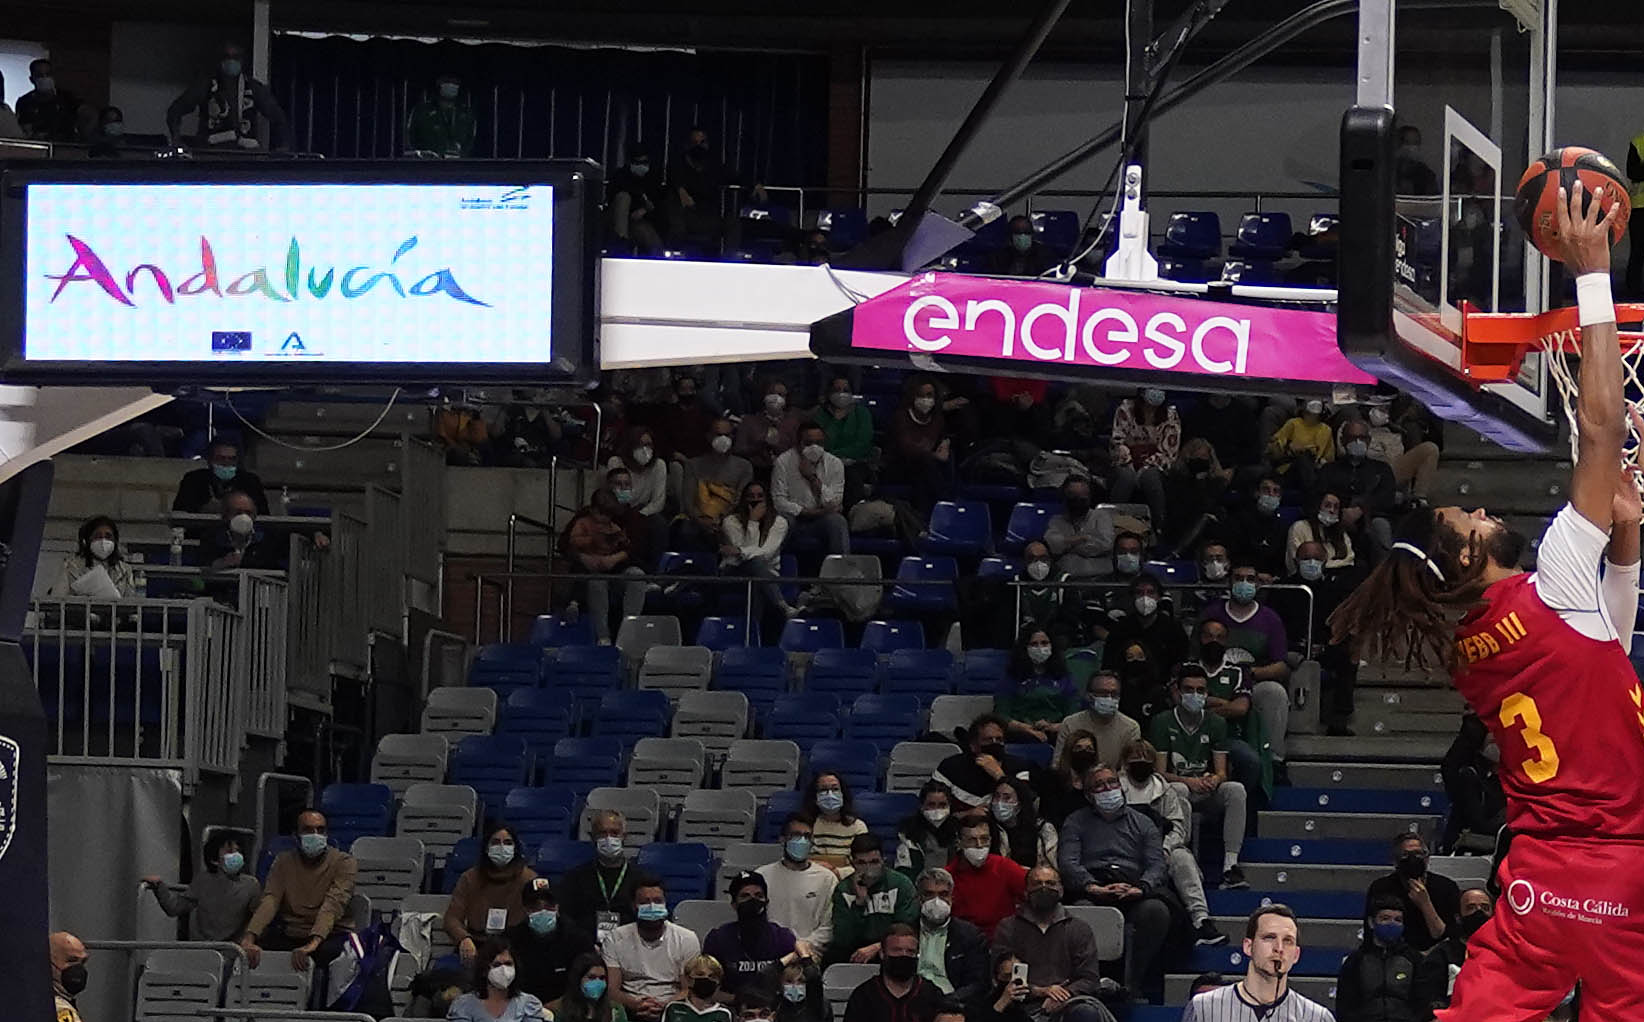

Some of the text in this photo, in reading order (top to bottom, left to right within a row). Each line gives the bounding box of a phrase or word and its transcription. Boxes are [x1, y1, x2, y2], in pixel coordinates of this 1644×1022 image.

[44, 234, 494, 309] Andalucía
[903, 288, 1251, 374] endesa
[1499, 692, 1560, 783] 3
[1540, 891, 1629, 917] Costa Cálida
